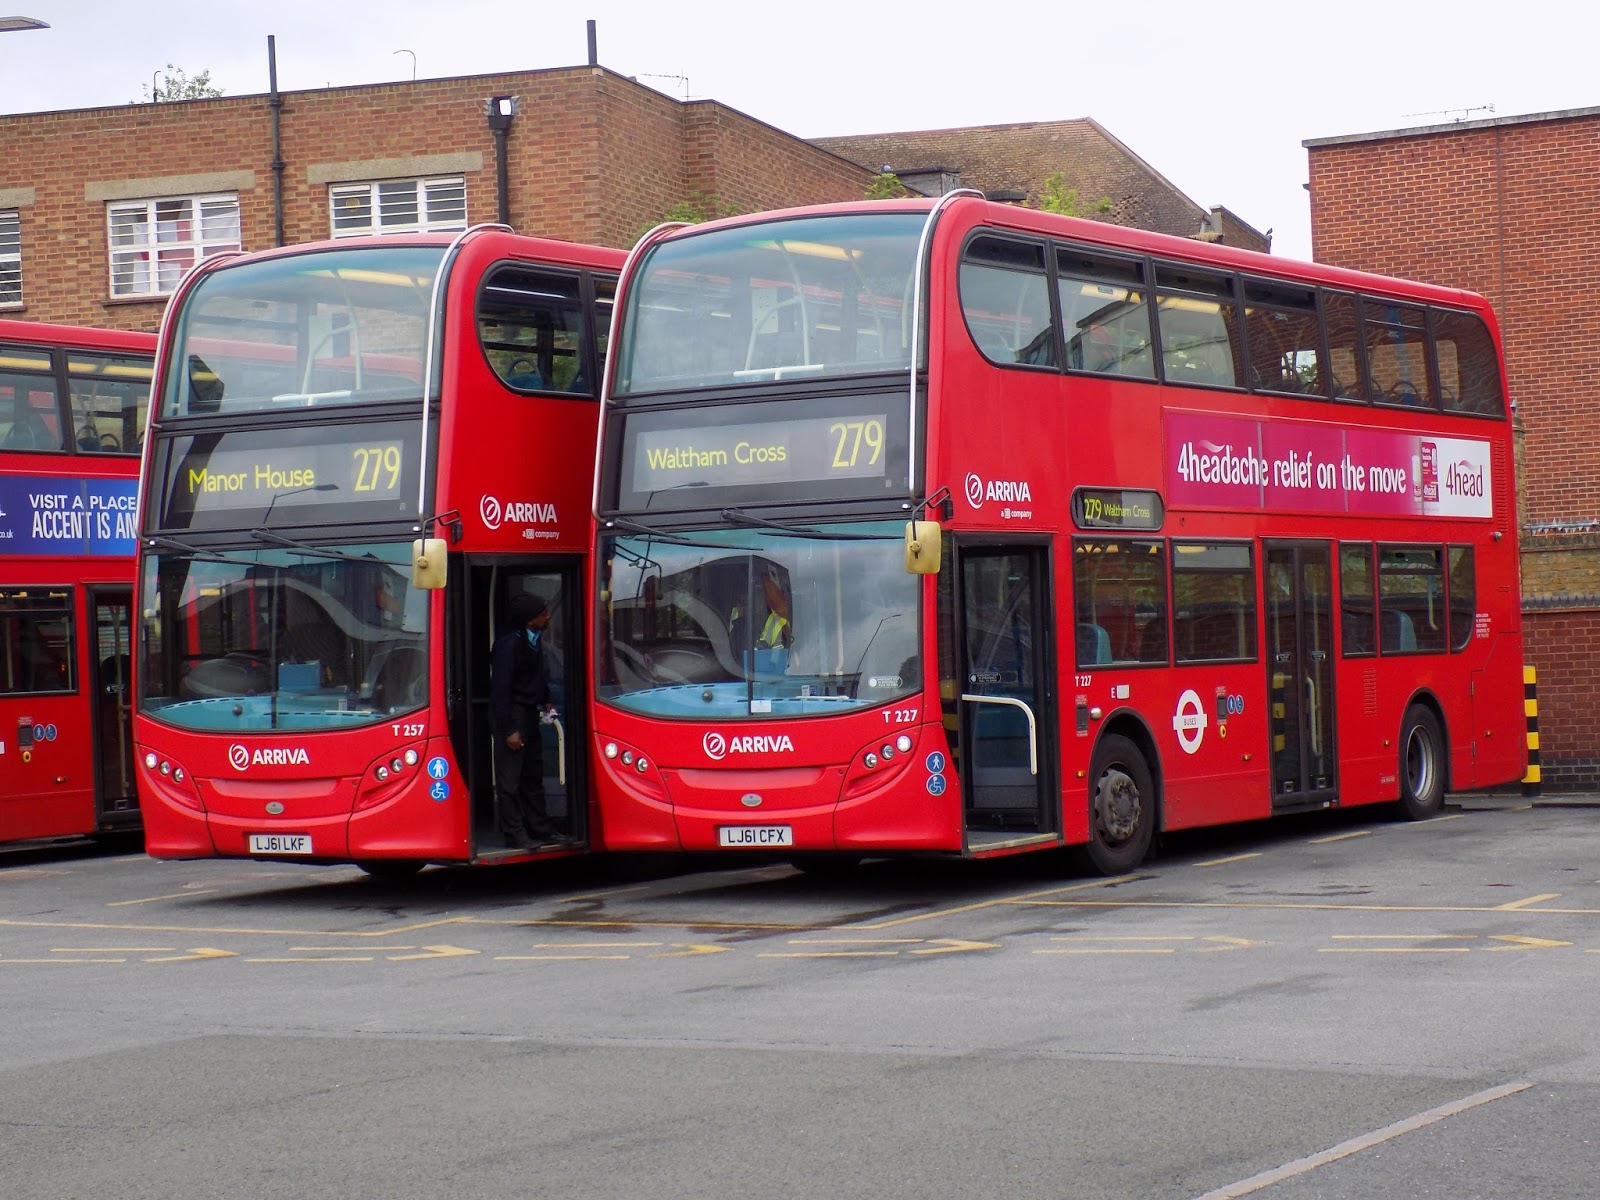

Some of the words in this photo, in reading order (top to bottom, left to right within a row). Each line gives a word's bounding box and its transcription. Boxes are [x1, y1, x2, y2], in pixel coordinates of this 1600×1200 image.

[830, 420, 883, 468] 279
[647, 447, 727, 470] Waltham
[734, 441, 787, 463] Cross
[352, 445, 401, 493] 279
[1177, 442, 1269, 487] 4headache
[1273, 449, 1313, 489] relief
[1316, 462, 1337, 490] on
[1340, 454, 1366, 492] the
[1369, 465, 1407, 494] move
[188, 466, 248, 494] Manor
[254, 463, 315, 490] House
[1445, 462, 1484, 498] 4head
[986, 480, 1031, 502] ARRIVA
[29, 494, 68, 509] VISIT
[72, 495, 84, 510] A
[90, 496, 136, 510] PLACE
[1084, 498, 1102, 519] 279
[1104, 503, 1131, 517] Waltham
[1133, 505, 1150, 518] Cross
[504, 502, 557, 523] ARRIVA
[1011, 511, 1032, 519] company
[32, 511, 92, 539] ACCENT
[97, 512, 110, 539] IS
[115, 512, 136, 539] AN
[535, 531, 559, 540] company
[1074, 676, 1080, 687] T
[1080, 675, 1092, 687] 227
[1110, 687, 1116, 699] E
[882, 711, 891, 723] T
[895, 709, 918, 722] 227
[1184, 717, 1196, 726] BUSES
[392, 725, 400, 737] T
[403, 724, 425, 737] 257
[730, 735, 794, 753] ARRIVA
[252, 749, 310, 764] ARRIVA
[256, 838, 281, 851] LJ61
[283, 837, 305, 851] LKF
[727, 829, 757, 844] LJ61
[759, 828, 785, 844] CFX
